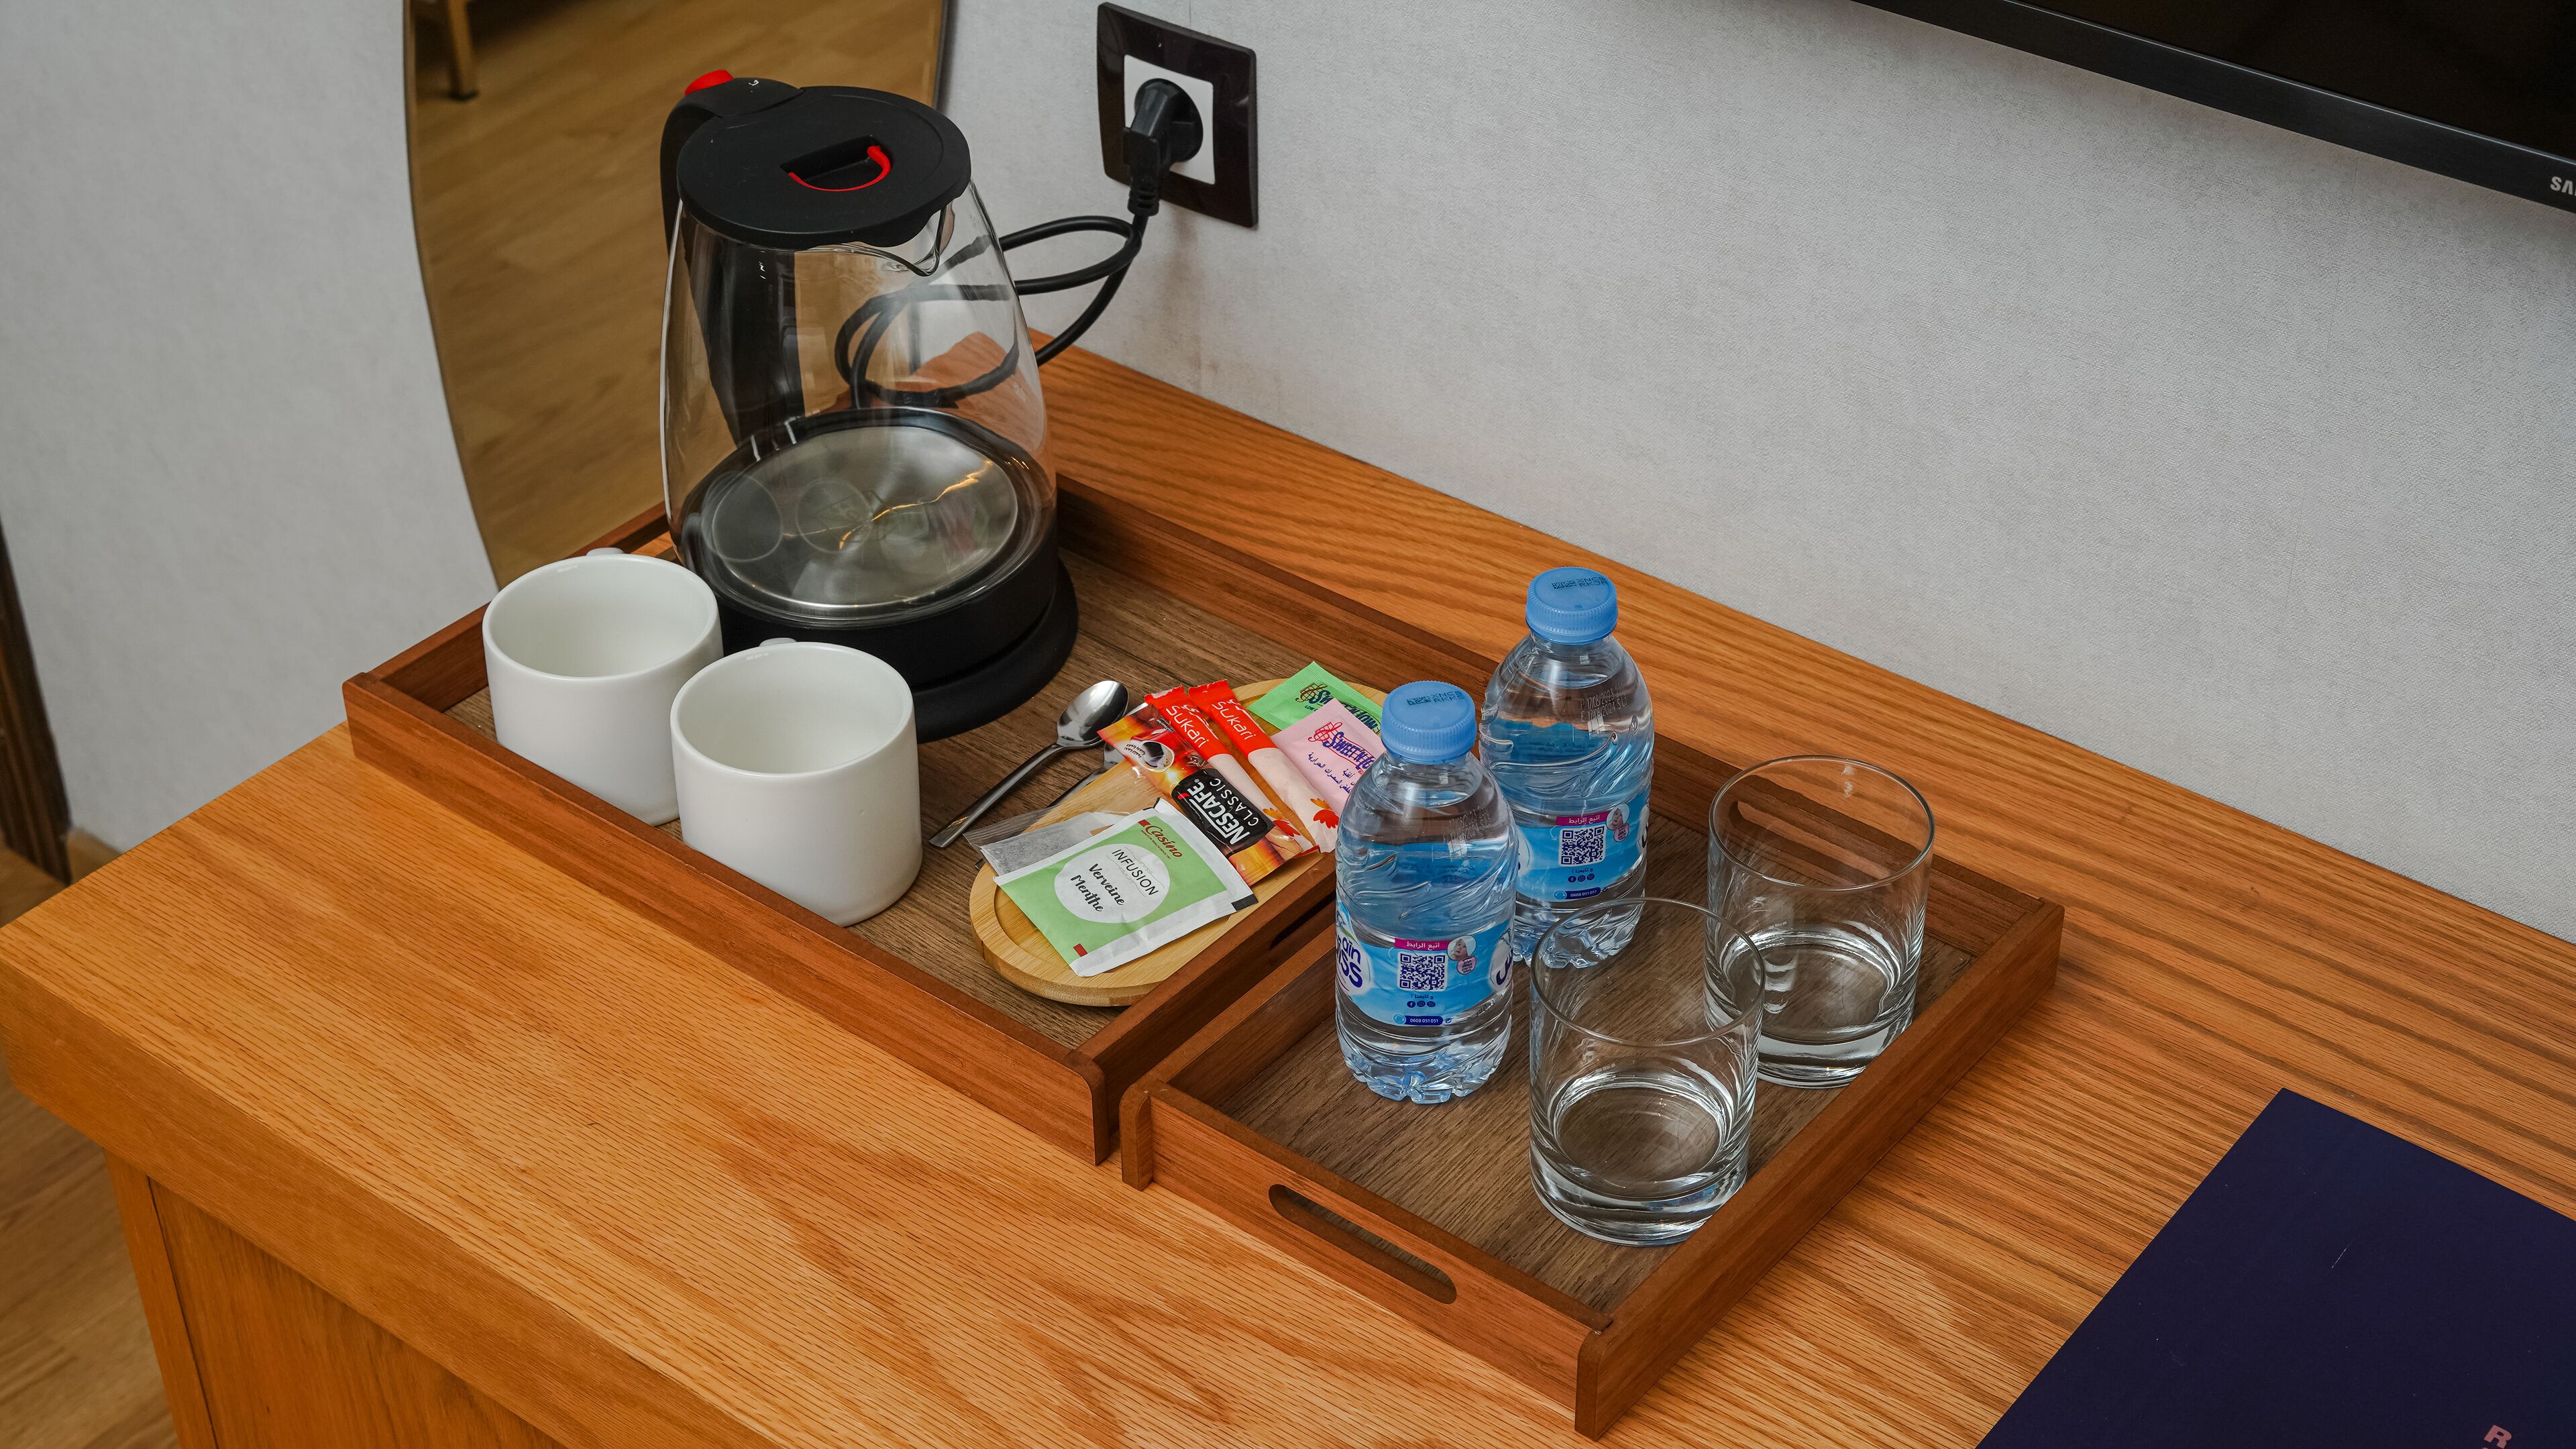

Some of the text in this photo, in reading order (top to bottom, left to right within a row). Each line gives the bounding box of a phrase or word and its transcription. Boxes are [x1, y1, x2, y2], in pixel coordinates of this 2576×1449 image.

[2550, 176, 2576, 196] SA
[1166, 705, 1209, 748] Sukari
[1212, 701, 1256, 740] Sukari
[1210, 778, 1259, 826] CLASSIC
[1145, 825, 1183, 857] Casino
[1089, 863, 1125, 906] Verveine
[1112, 849, 1159, 896] INFUSION
[1070, 875, 1104, 912] Menthe
[1428, 942, 1440, 951] اتبع
